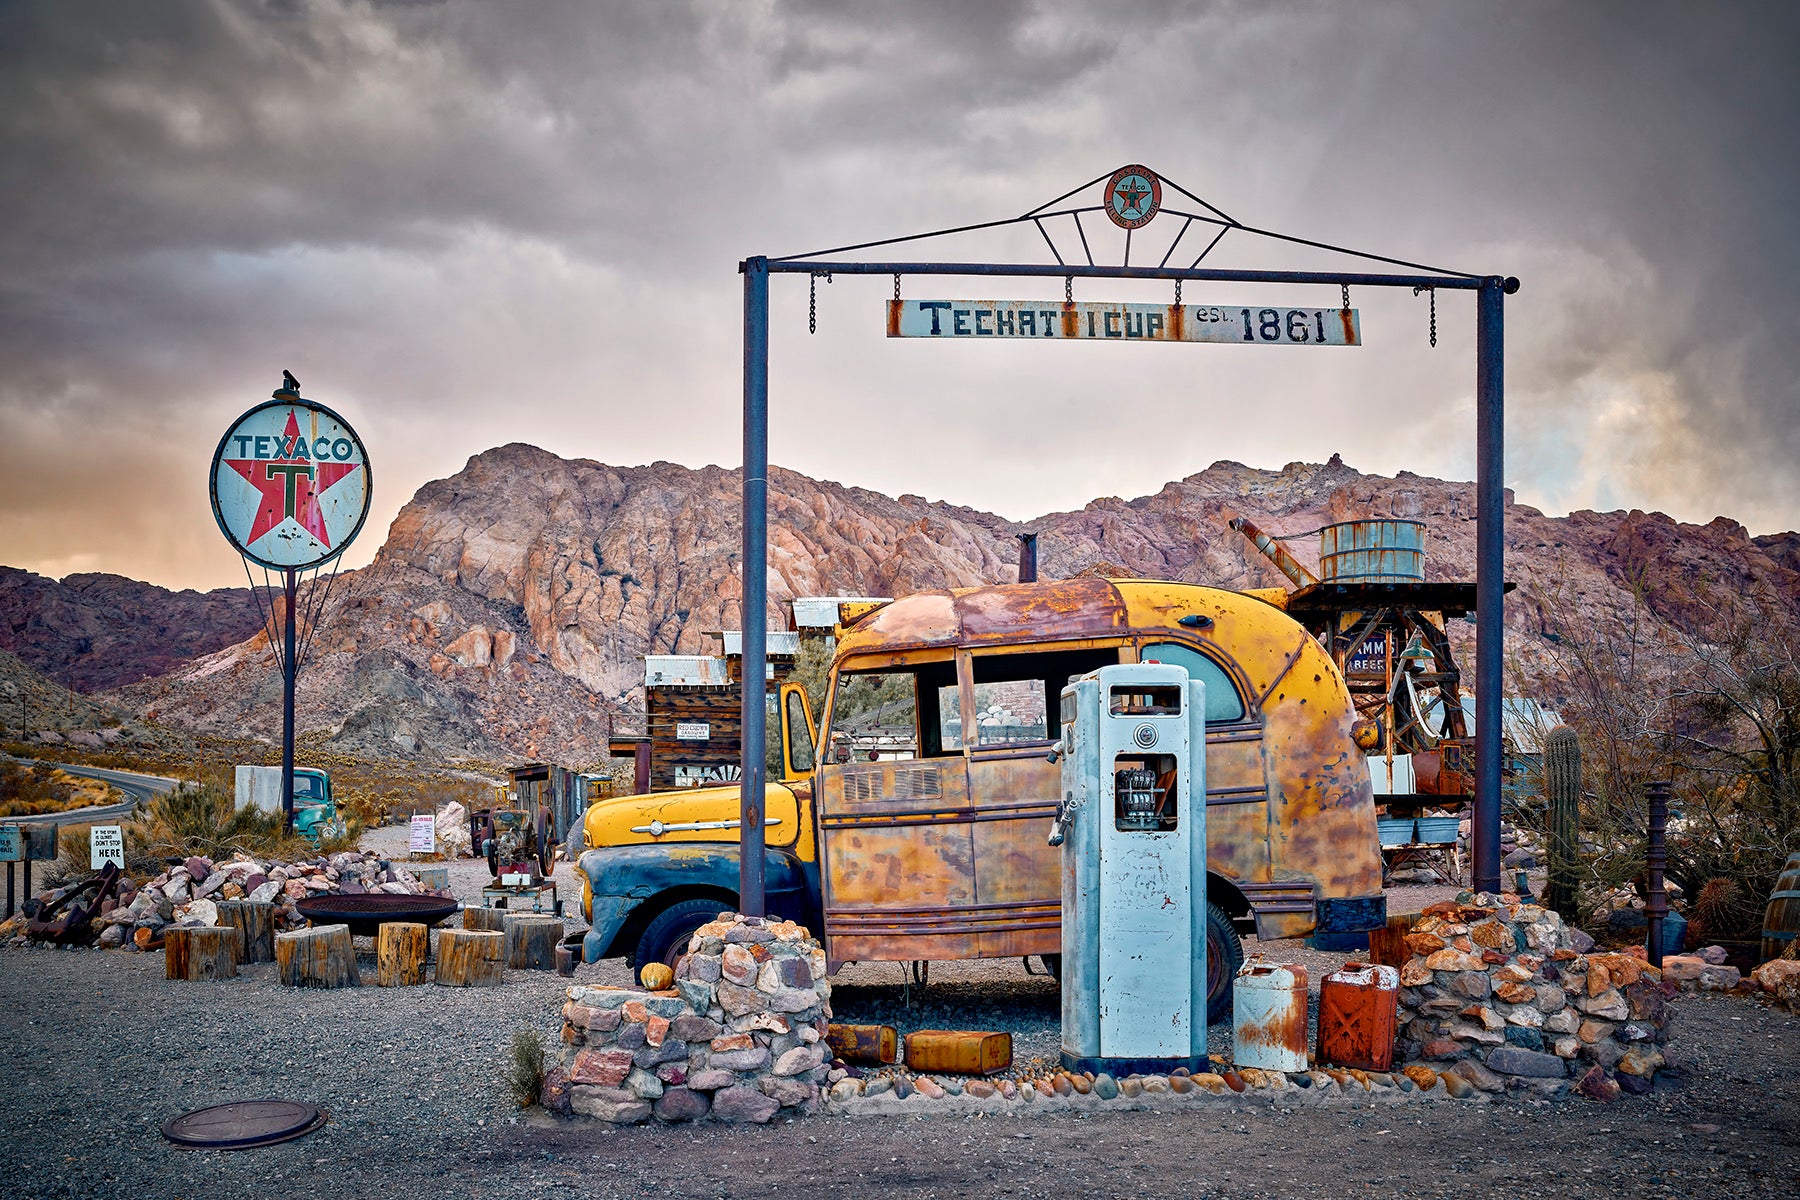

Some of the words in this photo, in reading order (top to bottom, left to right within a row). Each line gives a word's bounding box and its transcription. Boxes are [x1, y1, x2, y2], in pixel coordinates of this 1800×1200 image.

[233, 435, 354, 462] TEXACO
[266, 464, 315, 521] T
[1354, 659, 1385, 670] BEER
[99, 848, 121, 858] HERE
